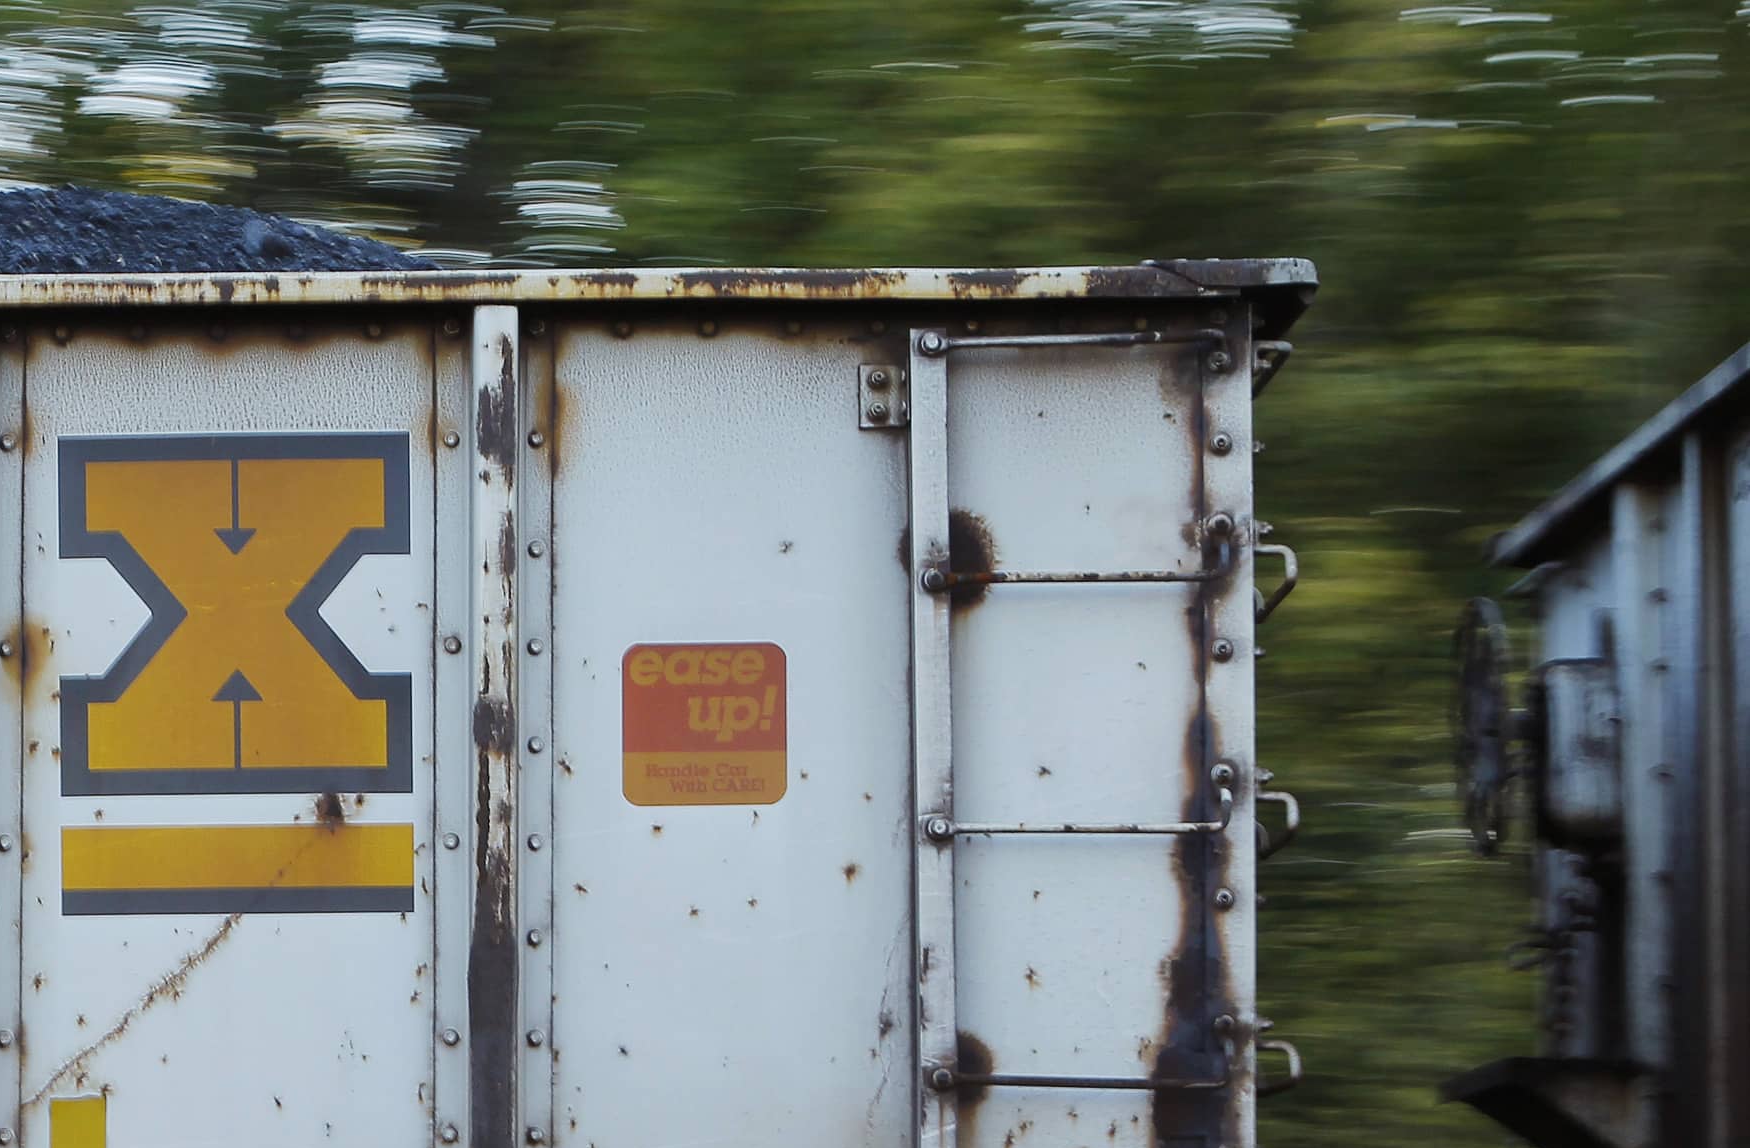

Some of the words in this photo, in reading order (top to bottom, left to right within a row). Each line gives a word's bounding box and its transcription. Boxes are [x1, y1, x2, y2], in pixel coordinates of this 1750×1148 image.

[629, 650, 765, 686] ease
[688, 685, 778, 742] up!
[645, 763, 710, 777] Handle
